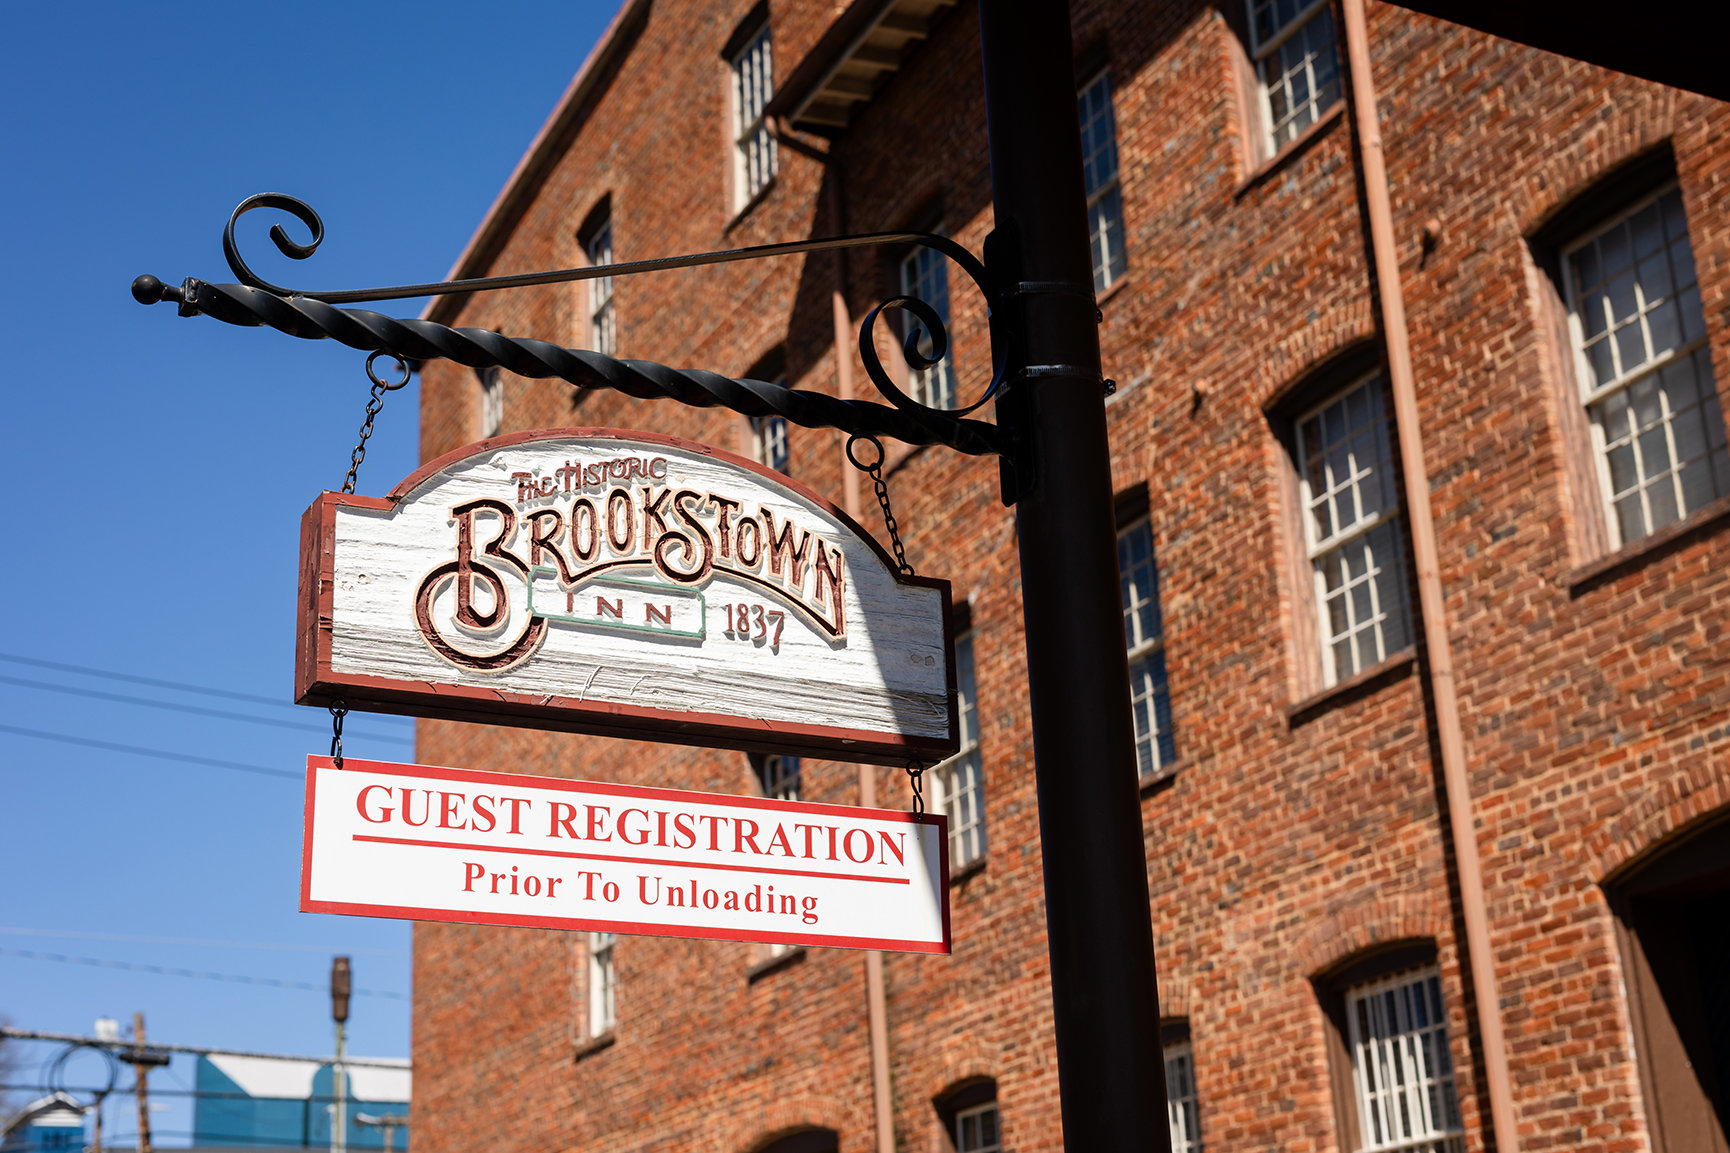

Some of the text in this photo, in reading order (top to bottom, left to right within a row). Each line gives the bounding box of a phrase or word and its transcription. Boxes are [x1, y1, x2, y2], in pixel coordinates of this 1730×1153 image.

[413, 486, 847, 674] BROOKSTOWN
[566, 592, 672, 625] INN
[723, 603, 784, 646] 1837
[356, 784, 906, 867] GUEST REGISTRATION
[463, 862, 819, 925] Prior To Unloading
